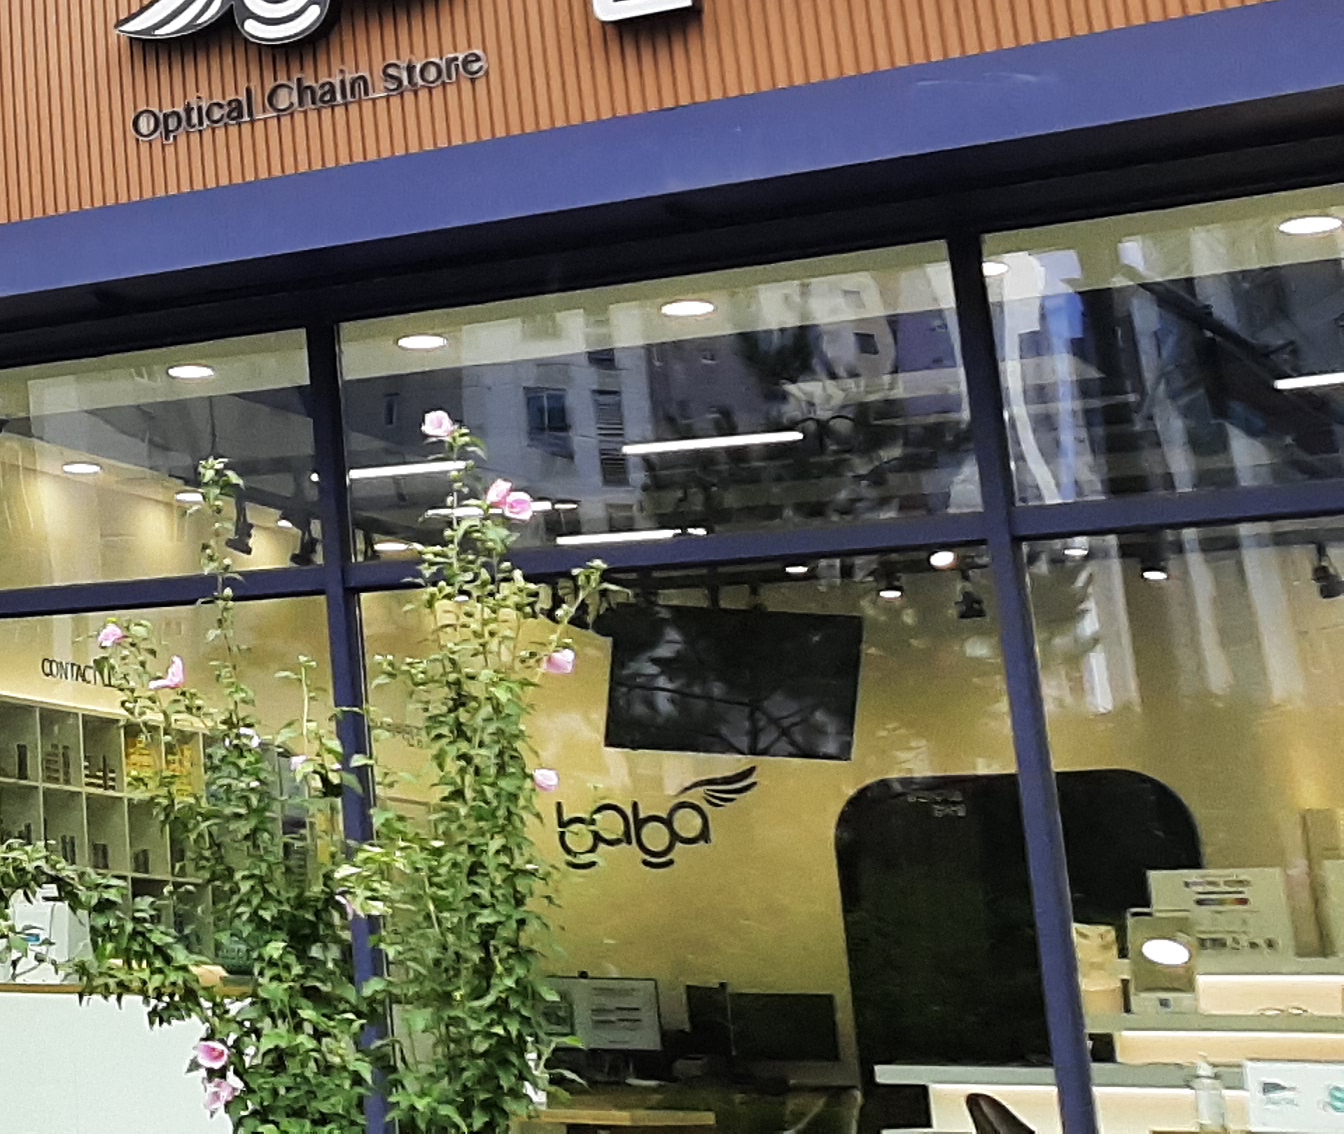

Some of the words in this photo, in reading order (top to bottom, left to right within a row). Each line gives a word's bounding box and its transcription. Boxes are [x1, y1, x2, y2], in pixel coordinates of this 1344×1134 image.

[132, 82, 258, 145] Optical
[265, 65, 373, 123] Chain
[380, 48, 489, 104] Store
